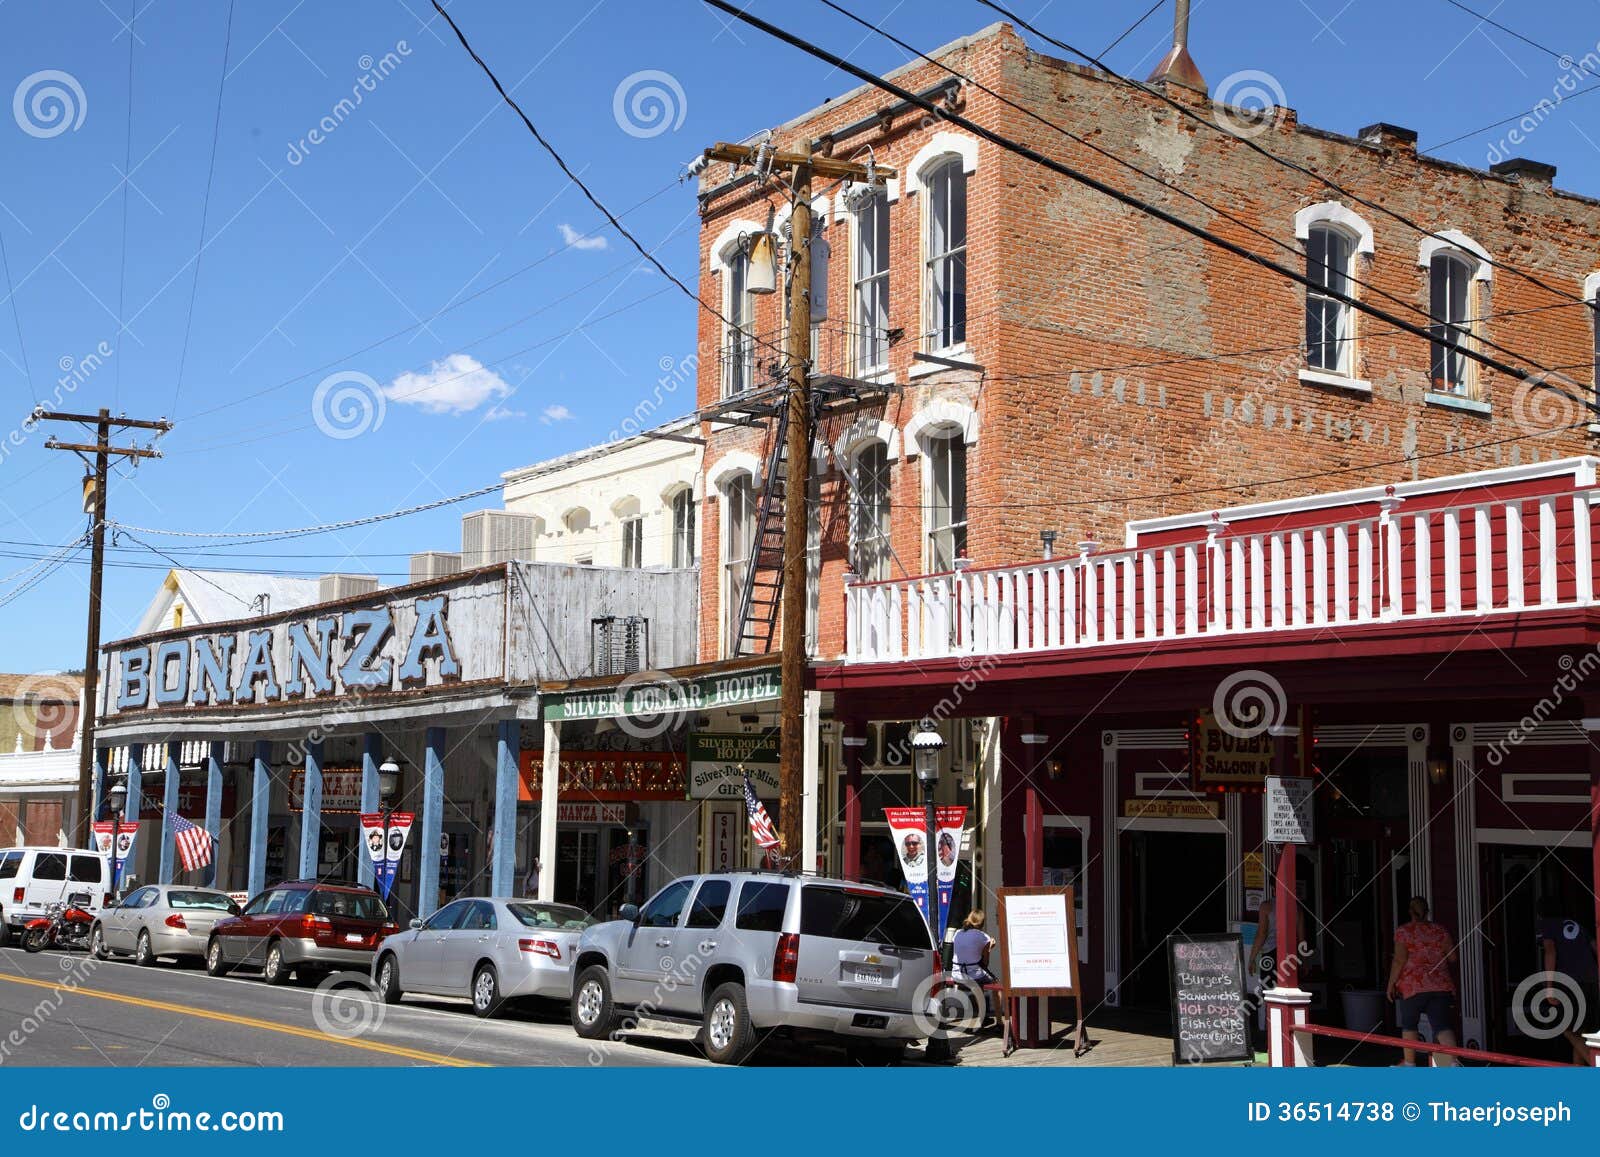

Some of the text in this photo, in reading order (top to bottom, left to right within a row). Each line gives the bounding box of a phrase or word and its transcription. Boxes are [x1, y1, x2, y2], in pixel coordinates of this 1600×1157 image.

[117, 594, 462, 711] BONANZA
[564, 673, 778, 717] SILVER DOLLAR HOTEL
[698, 738, 776, 750] SILVER DOLLAR
[717, 747, 753, 760] HOTEL
[530, 759, 687, 792] BNANZA
[557, 805, 598, 821] NANZA
